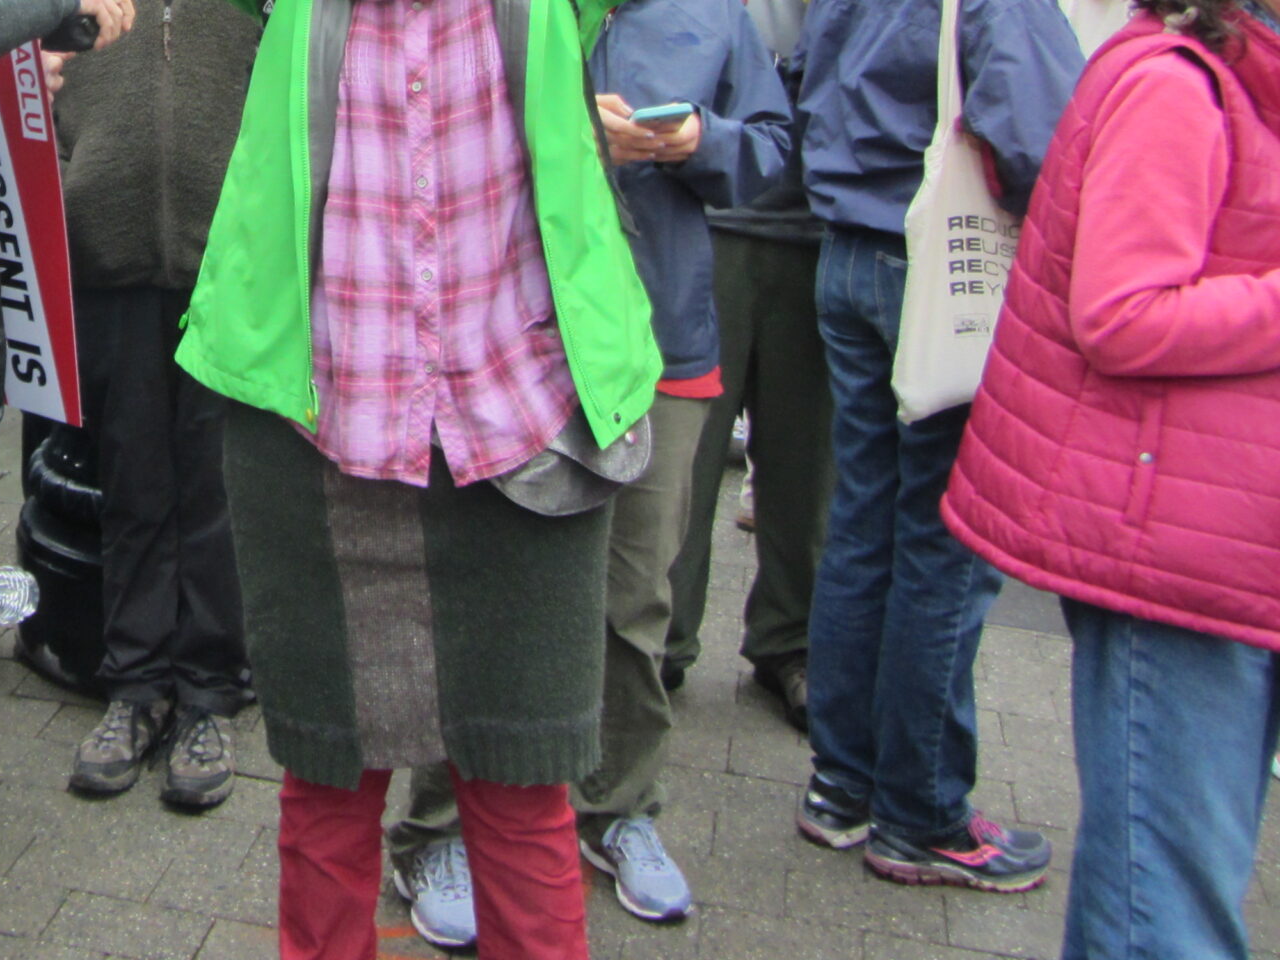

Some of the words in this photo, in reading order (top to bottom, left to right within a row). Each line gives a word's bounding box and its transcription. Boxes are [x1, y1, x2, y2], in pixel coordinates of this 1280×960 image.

[15, 48, 43, 134] ACLU
[949, 280, 1004, 296] REY
[7, 338, 47, 387] IS
